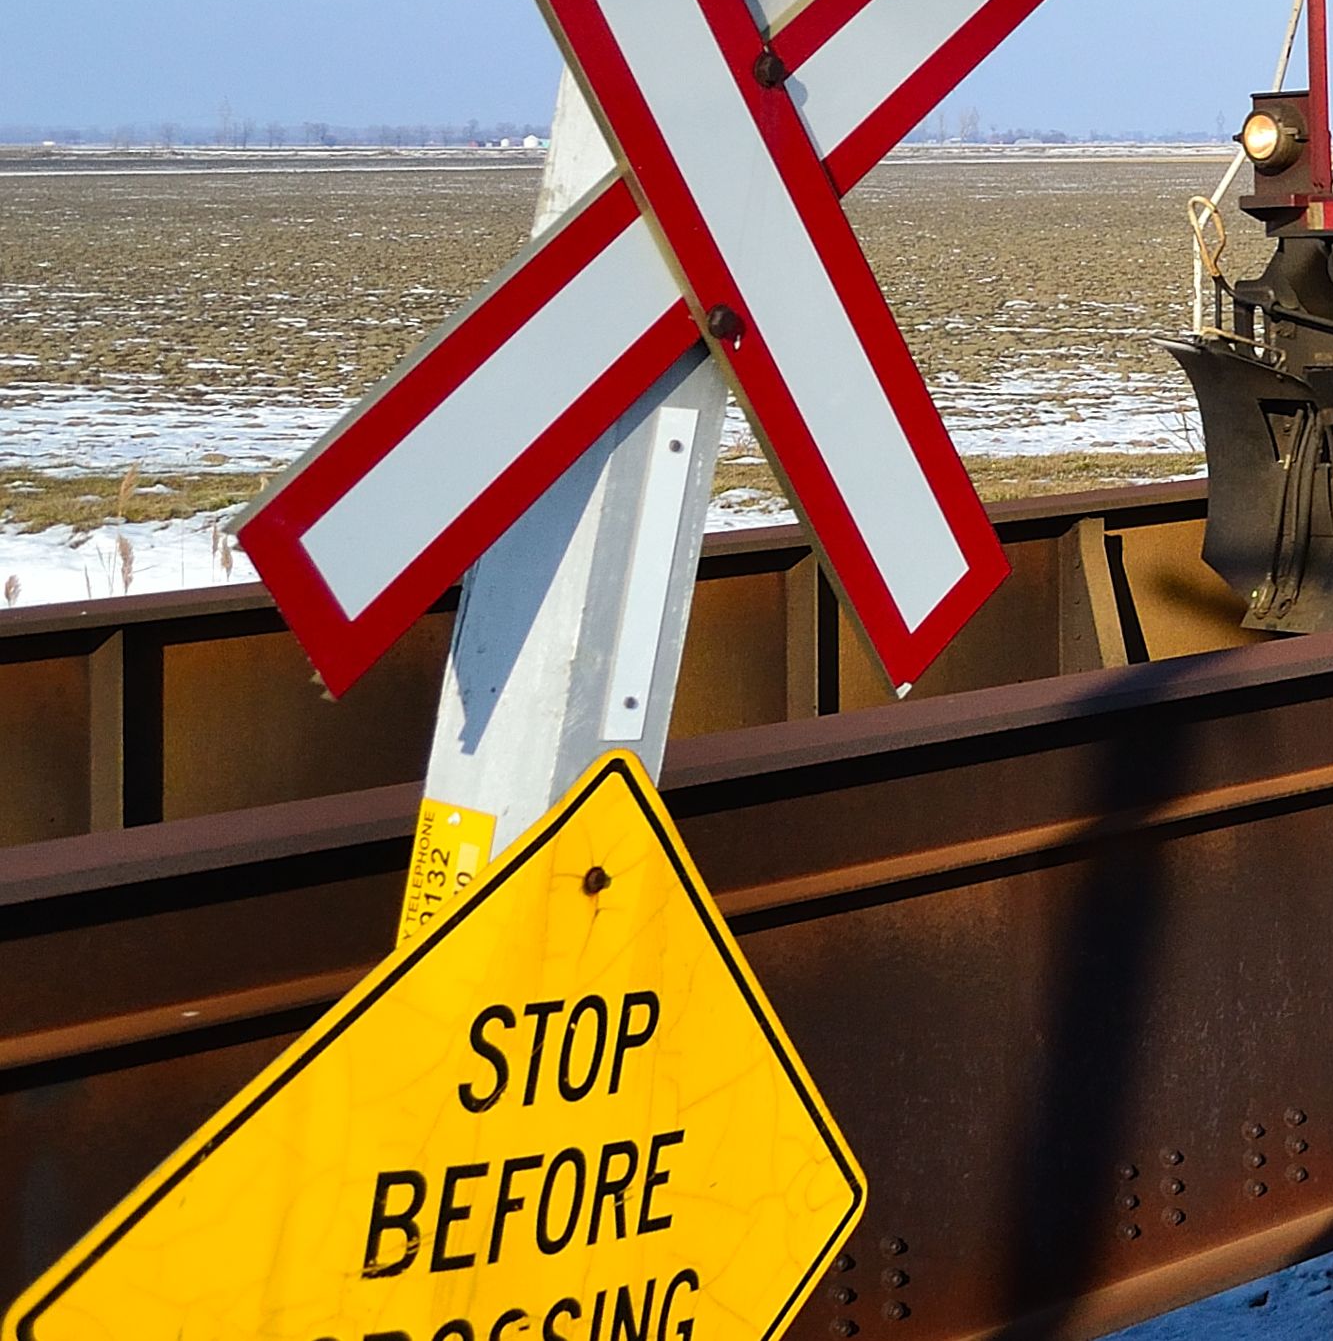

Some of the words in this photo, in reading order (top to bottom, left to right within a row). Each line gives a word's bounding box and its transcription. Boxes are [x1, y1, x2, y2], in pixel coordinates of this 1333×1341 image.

[405, 810, 435, 923] TELEPHONE
[457, 989, 661, 1115] STOP
[360, 1129, 685, 1280] BEFORE
[308, 1267, 700, 1341] SING
